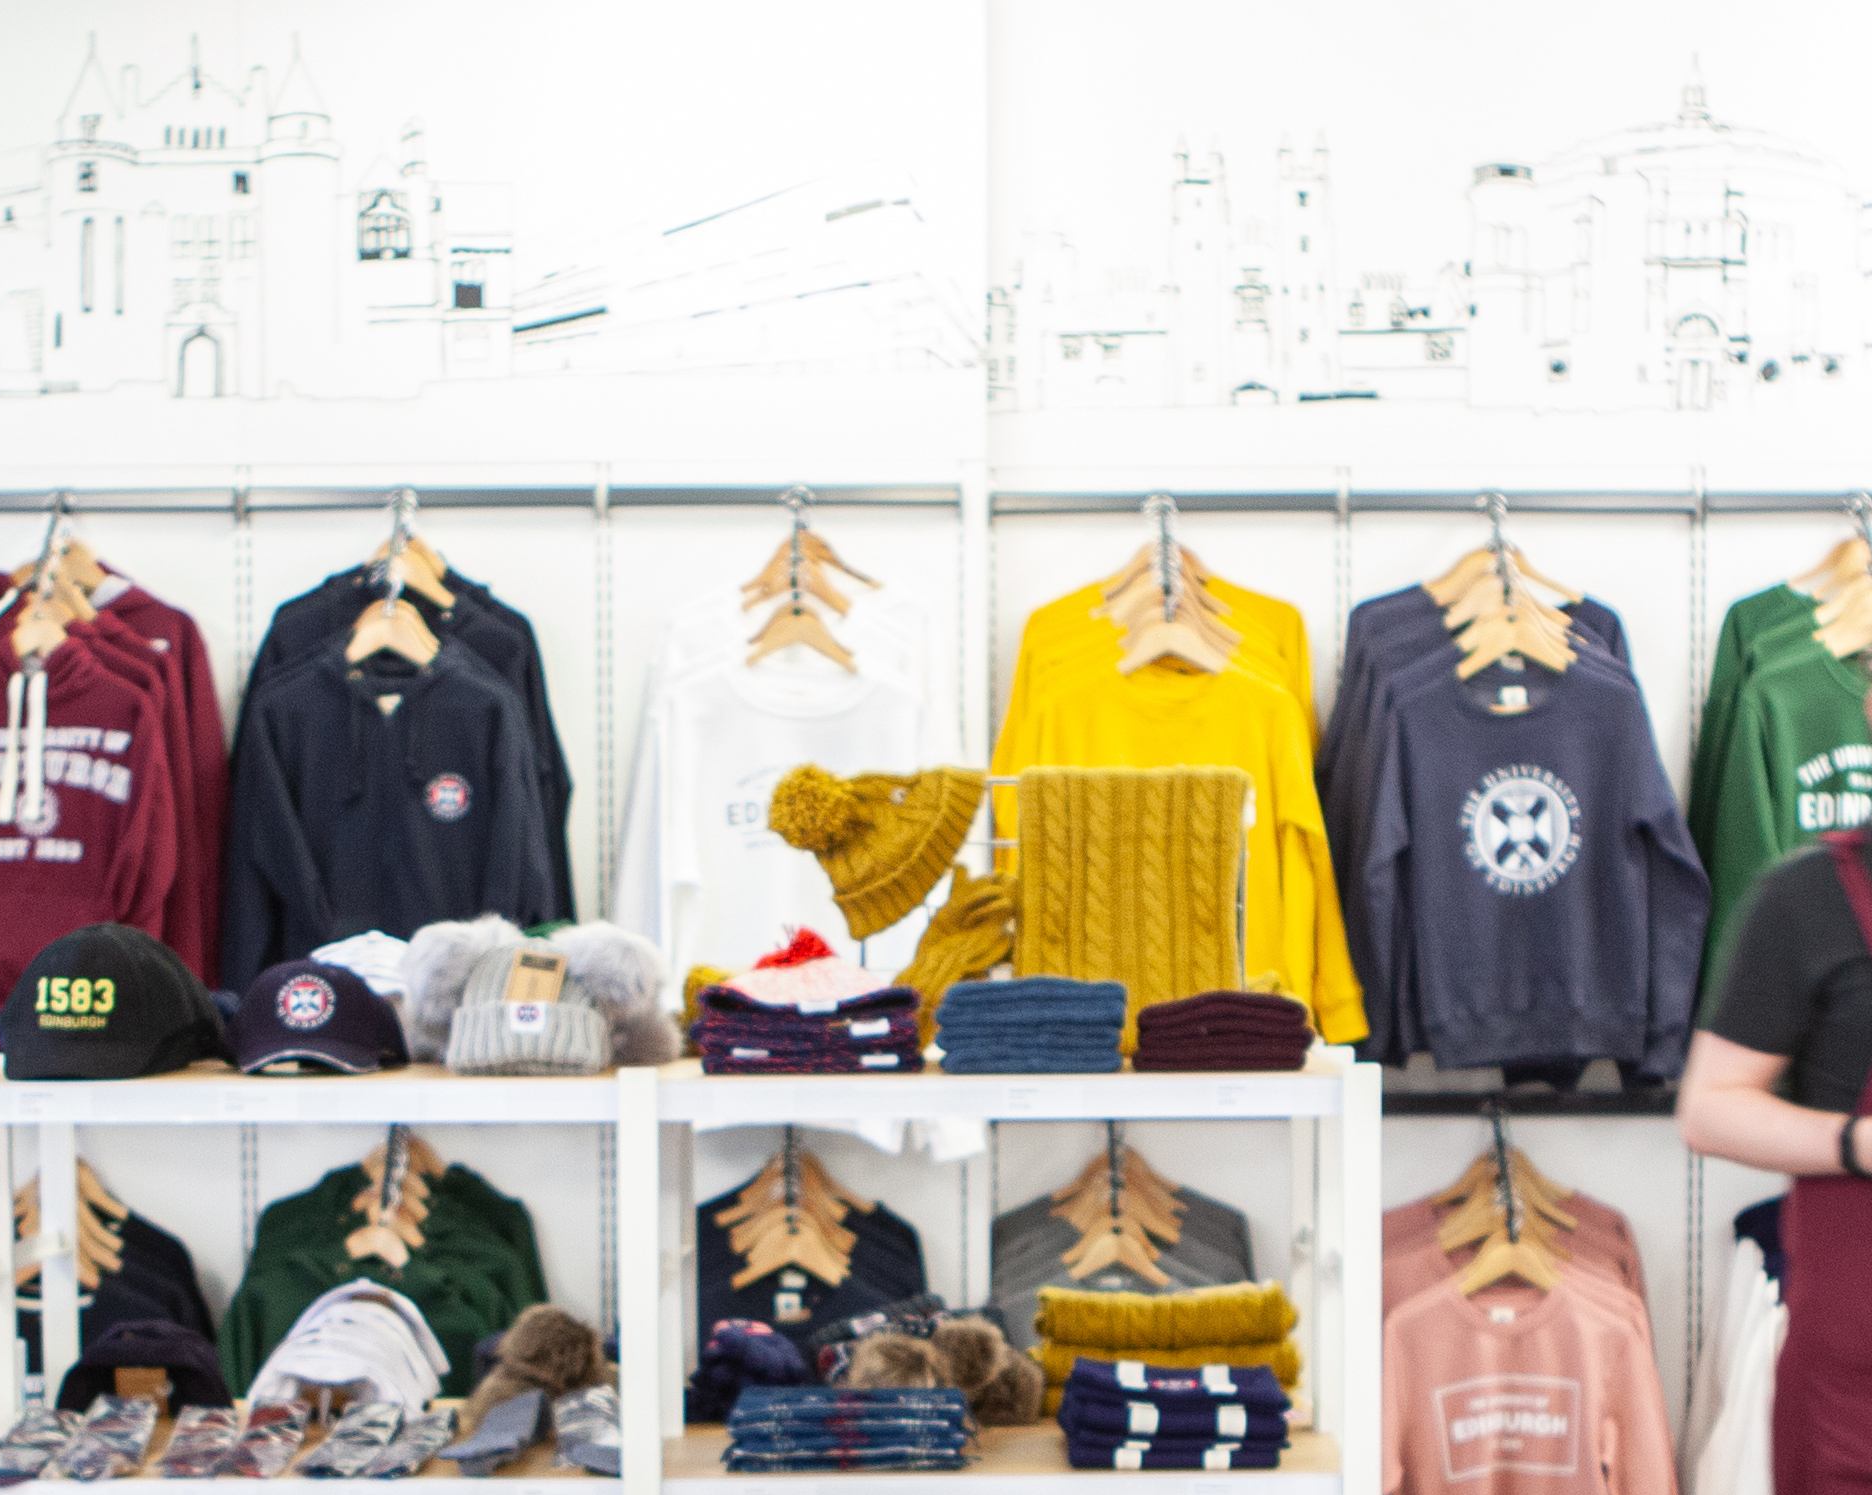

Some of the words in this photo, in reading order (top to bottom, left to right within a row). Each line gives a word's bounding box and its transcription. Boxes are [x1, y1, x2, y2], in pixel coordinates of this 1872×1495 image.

[1799, 752, 1834, 787] THE
[35, 976, 116, 1013] 1583
[39, 1014, 107, 1029] EDINBURGH
